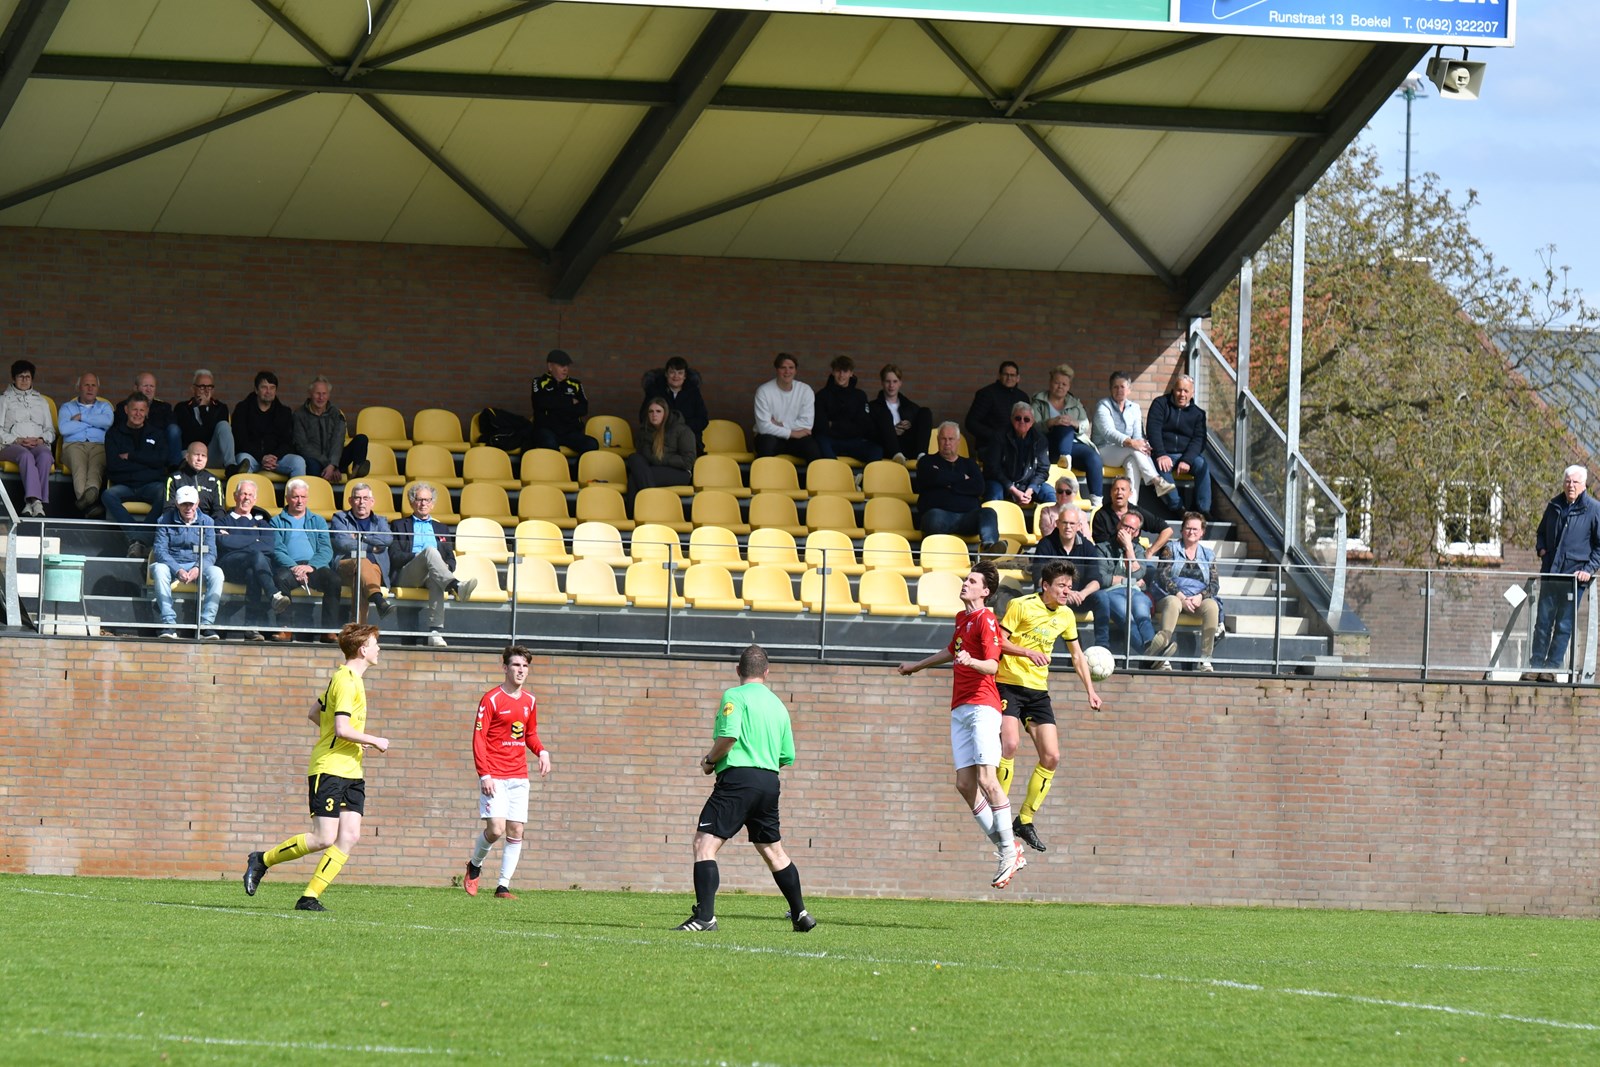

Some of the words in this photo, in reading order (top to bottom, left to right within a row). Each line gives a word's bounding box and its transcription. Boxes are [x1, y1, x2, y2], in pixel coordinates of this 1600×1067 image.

[1269, 10, 1326, 25] Runstraat
[1329, 13, 1344, 26] 13
[1350, 14, 1391, 28] Boekel
[1403, 16, 1413, 29] T.
[1416, 17, 1452, 33] (0492)
[1455, 19, 1499, 33] 322207
[325, 798, 334, 811] 3
